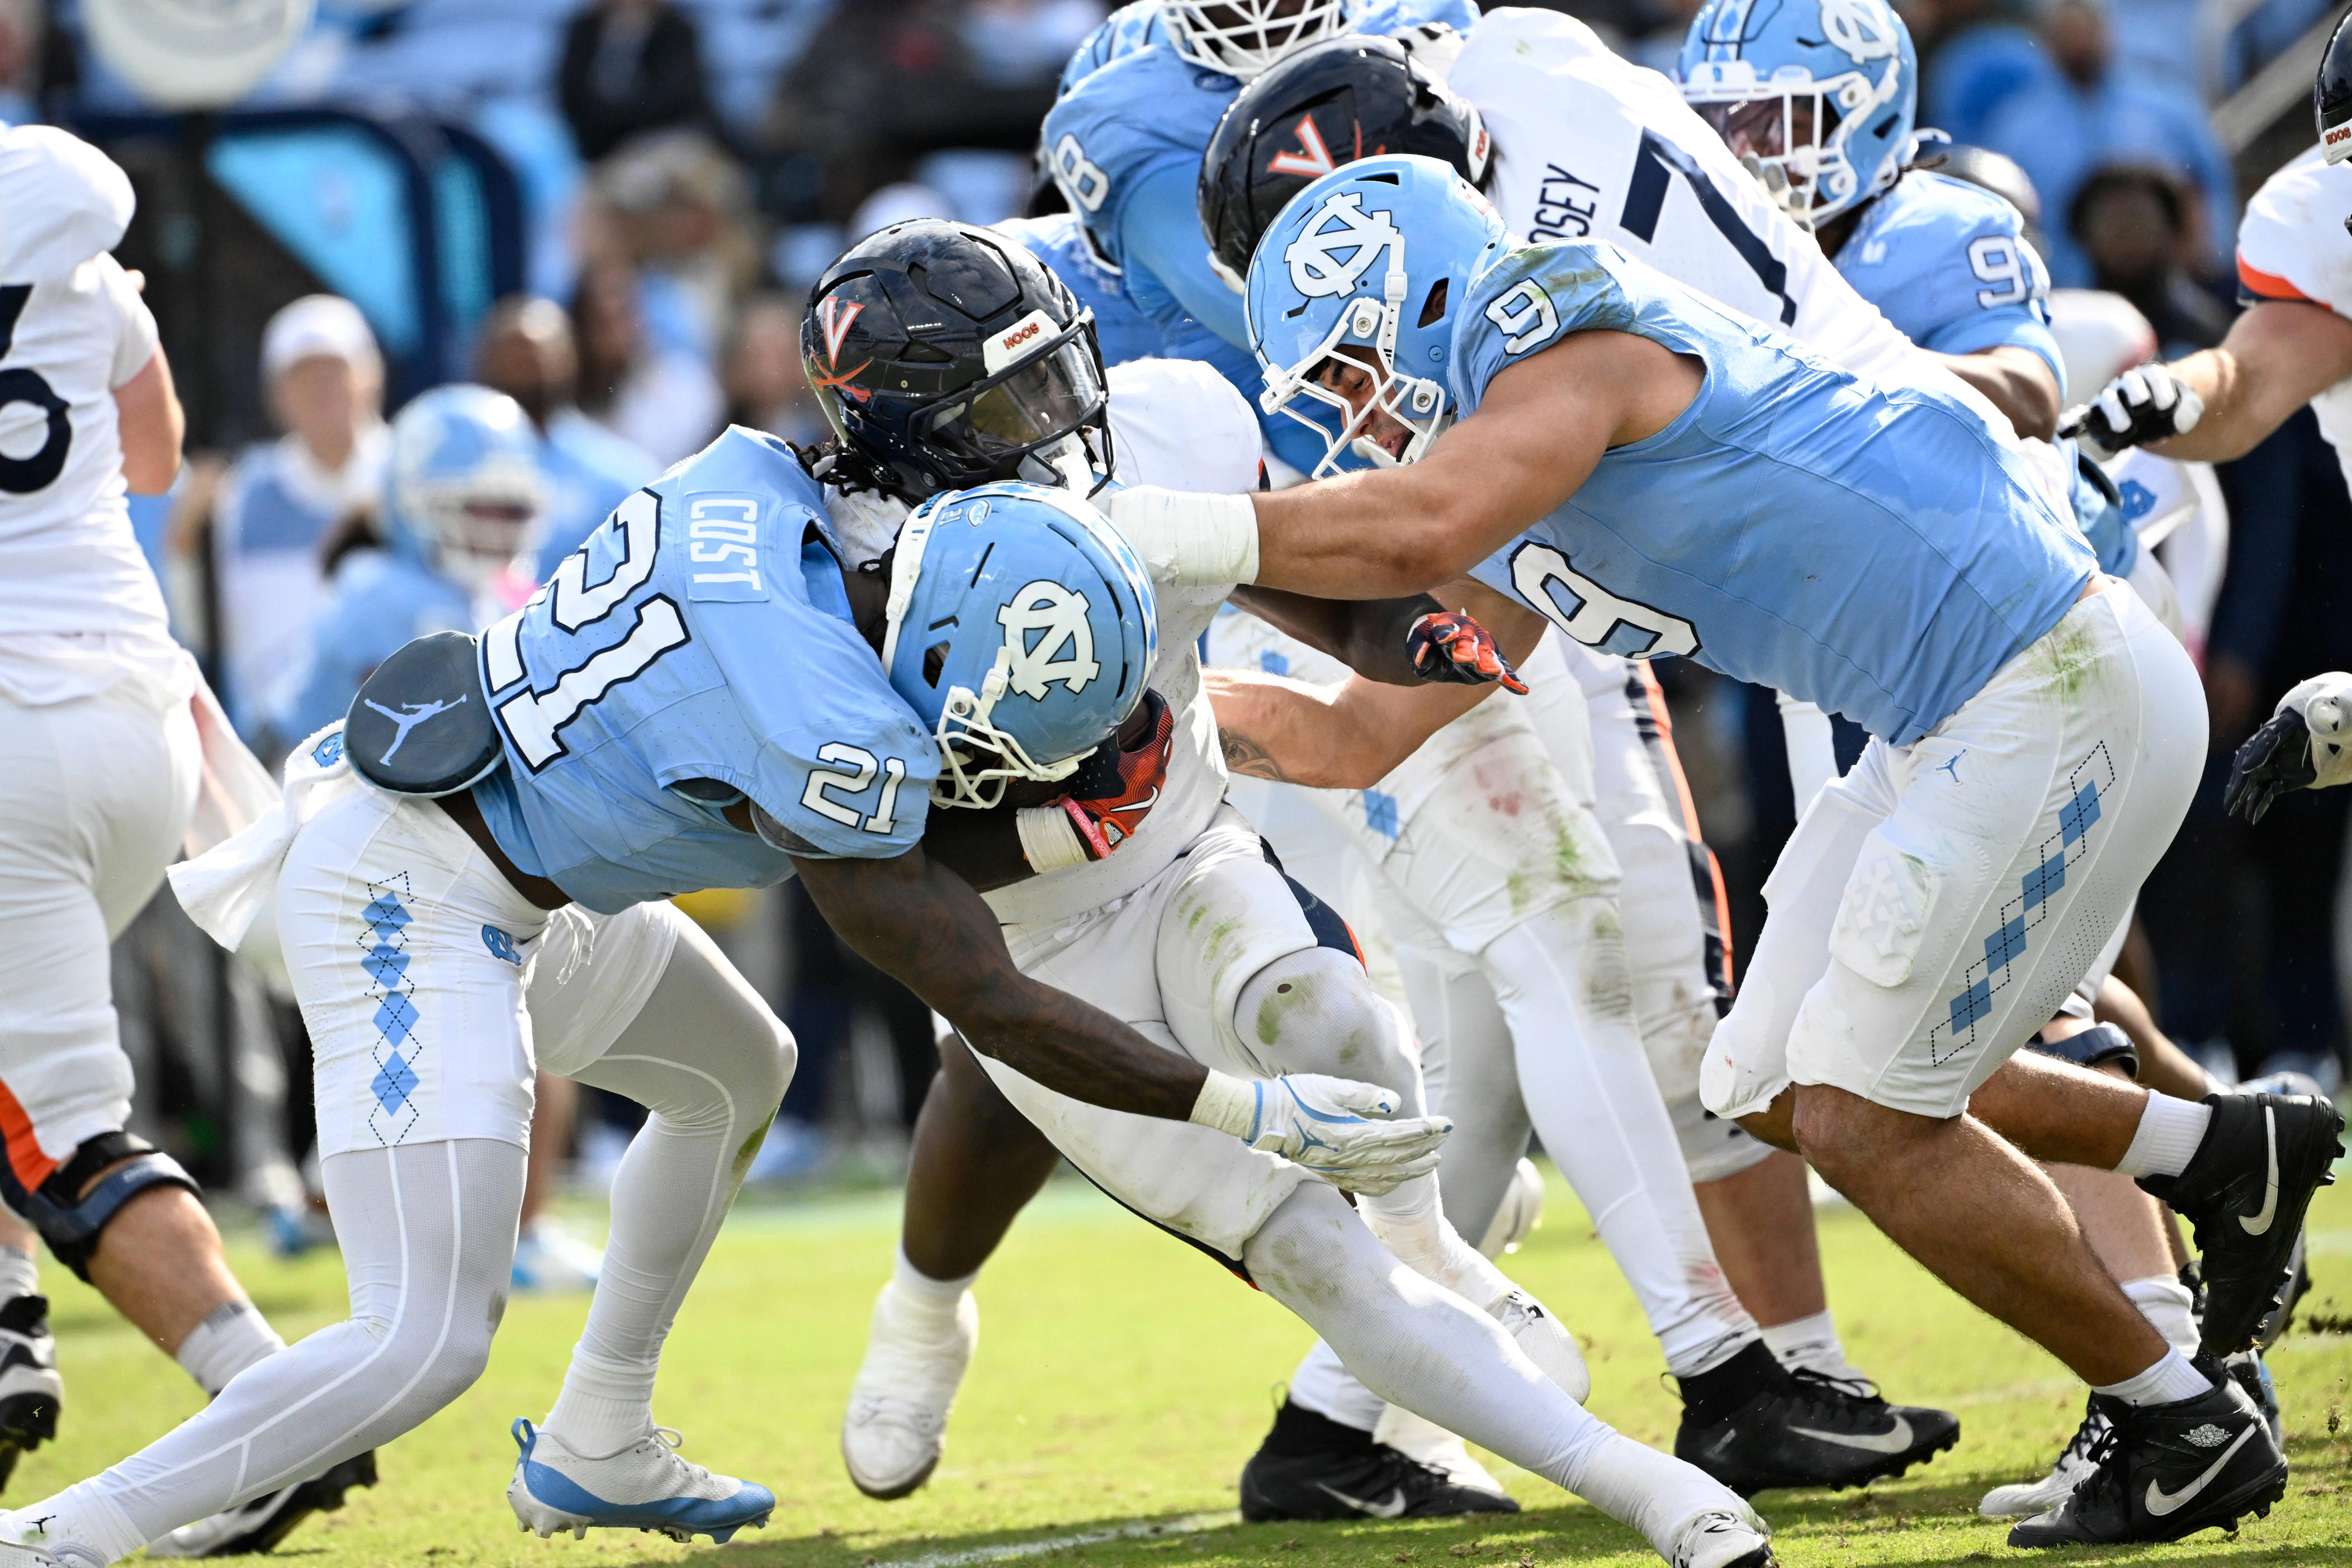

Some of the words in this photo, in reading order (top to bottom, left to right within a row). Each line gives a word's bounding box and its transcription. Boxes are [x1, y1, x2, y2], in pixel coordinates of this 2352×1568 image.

[1055, 132, 1110, 214] 8
[1620, 126, 1797, 327] 7
[1003, 321, 1040, 350] HOOS
[1483, 277, 1560, 356] 9
[689, 499, 762, 591] COST
[939, 507, 964, 527] 21
[482, 487, 691, 775] 21
[1509, 539, 1702, 660] 9
[799, 741, 906, 835] 21
[1073, 808, 1095, 839] VIRGINIA
[2203, 1424, 2223, 1434] JORDAN
